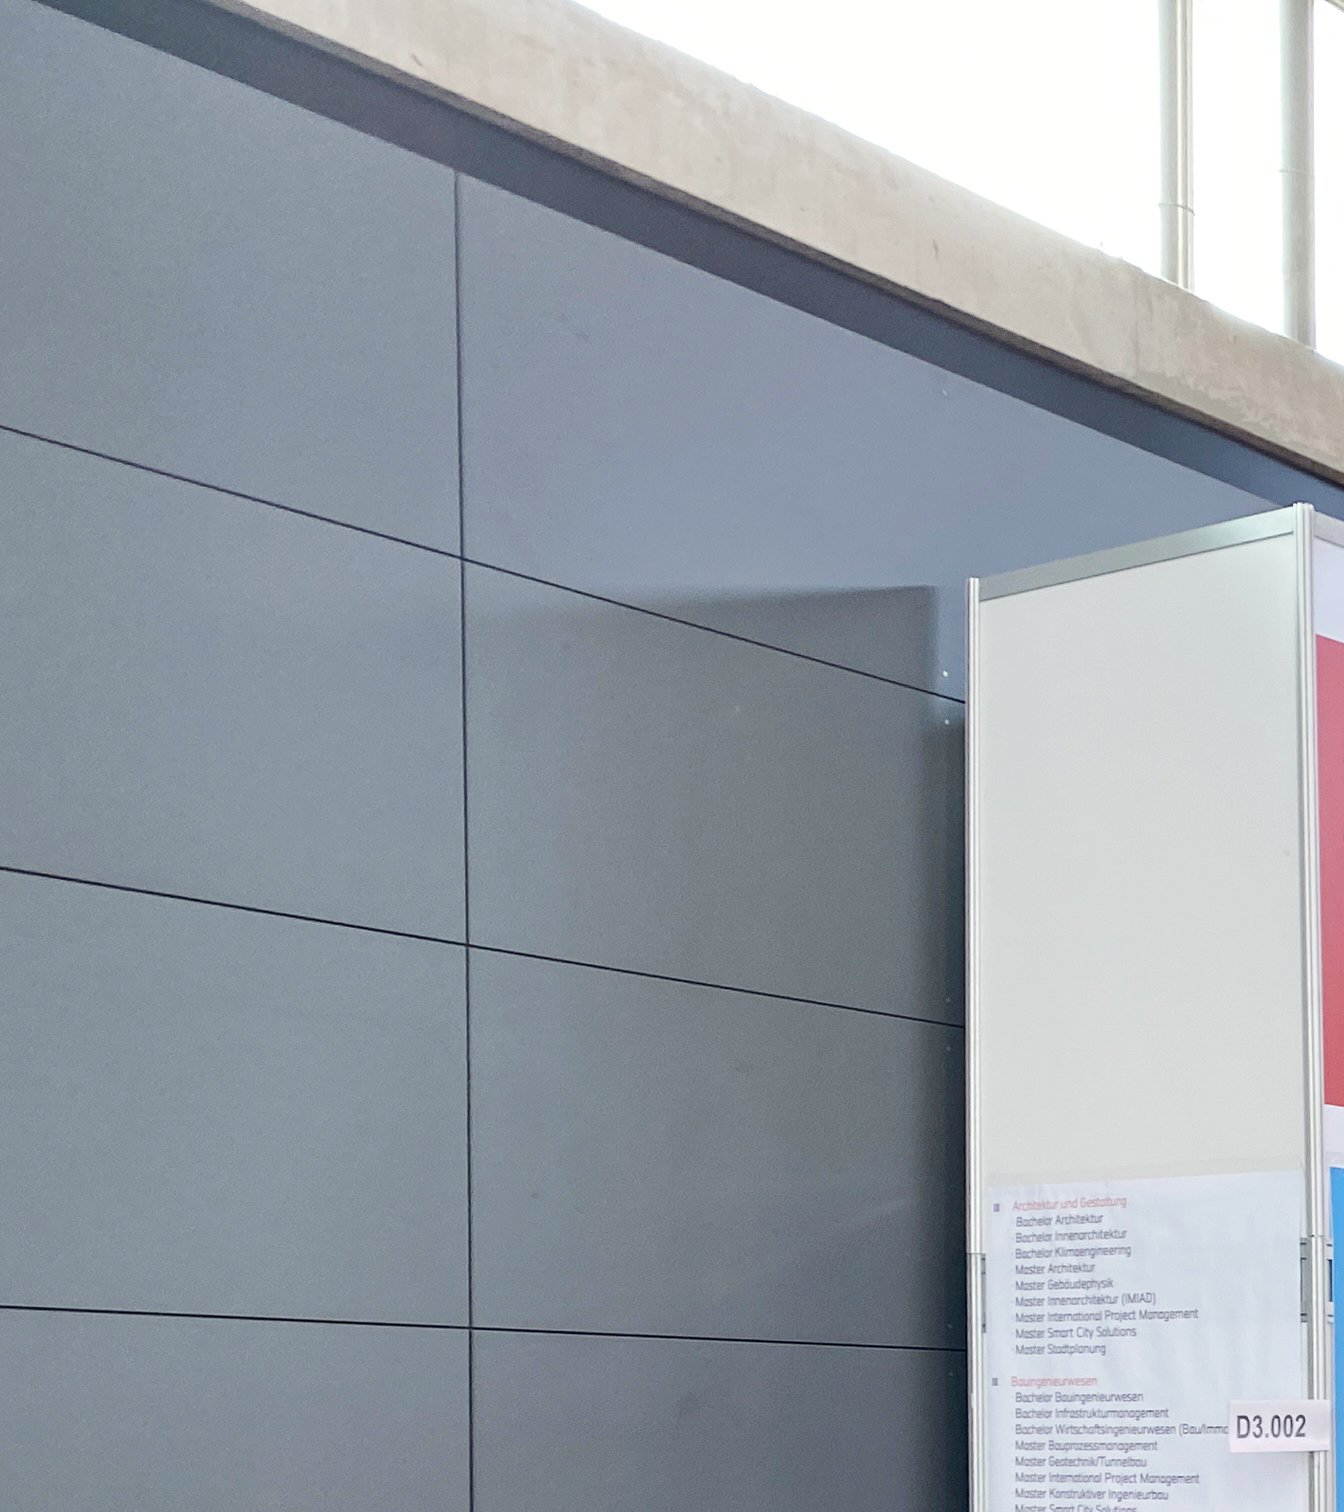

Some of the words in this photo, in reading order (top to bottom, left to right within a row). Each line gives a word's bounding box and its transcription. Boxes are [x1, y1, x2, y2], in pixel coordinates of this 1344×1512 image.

[1015, 1216, 1053, 1227] Bachelor
[1055, 1214, 1104, 1225] Architektur
[1015, 1232, 1053, 1243] Bachelor
[1015, 1248, 1053, 1259] Bachelor
[1015, 1264, 1045, 1275] Master
[1048, 1263, 1095, 1274] Architektur
[1015, 1280, 1045, 1291] Master
[1015, 1297, 1045, 1307] Master
[1015, 1312, 1045, 1323] Master
[1104, 1309, 1136, 1322] Project
[1139, 1309, 1199, 1322] Management
[1015, 1328, 1045, 1339] Master
[1047, 1327, 1074, 1338] Smart
[1015, 1344, 1045, 1355] Master
[1015, 1392, 1053, 1403] Bachelor
[1015, 1408, 1053, 1419] Bachelor
[1015, 1424, 1053, 1435] Bachelor
[1236, 1414, 1307, 1439] D3.002
[1015, 1440, 1045, 1451] Master
[1015, 1456, 1045, 1467] Master
[1015, 1471, 1045, 1483] Master
[1105, 1472, 1137, 1485] Project
[1140, 1473, 1200, 1486] Management
[1015, 1487, 1045, 1499] Master
